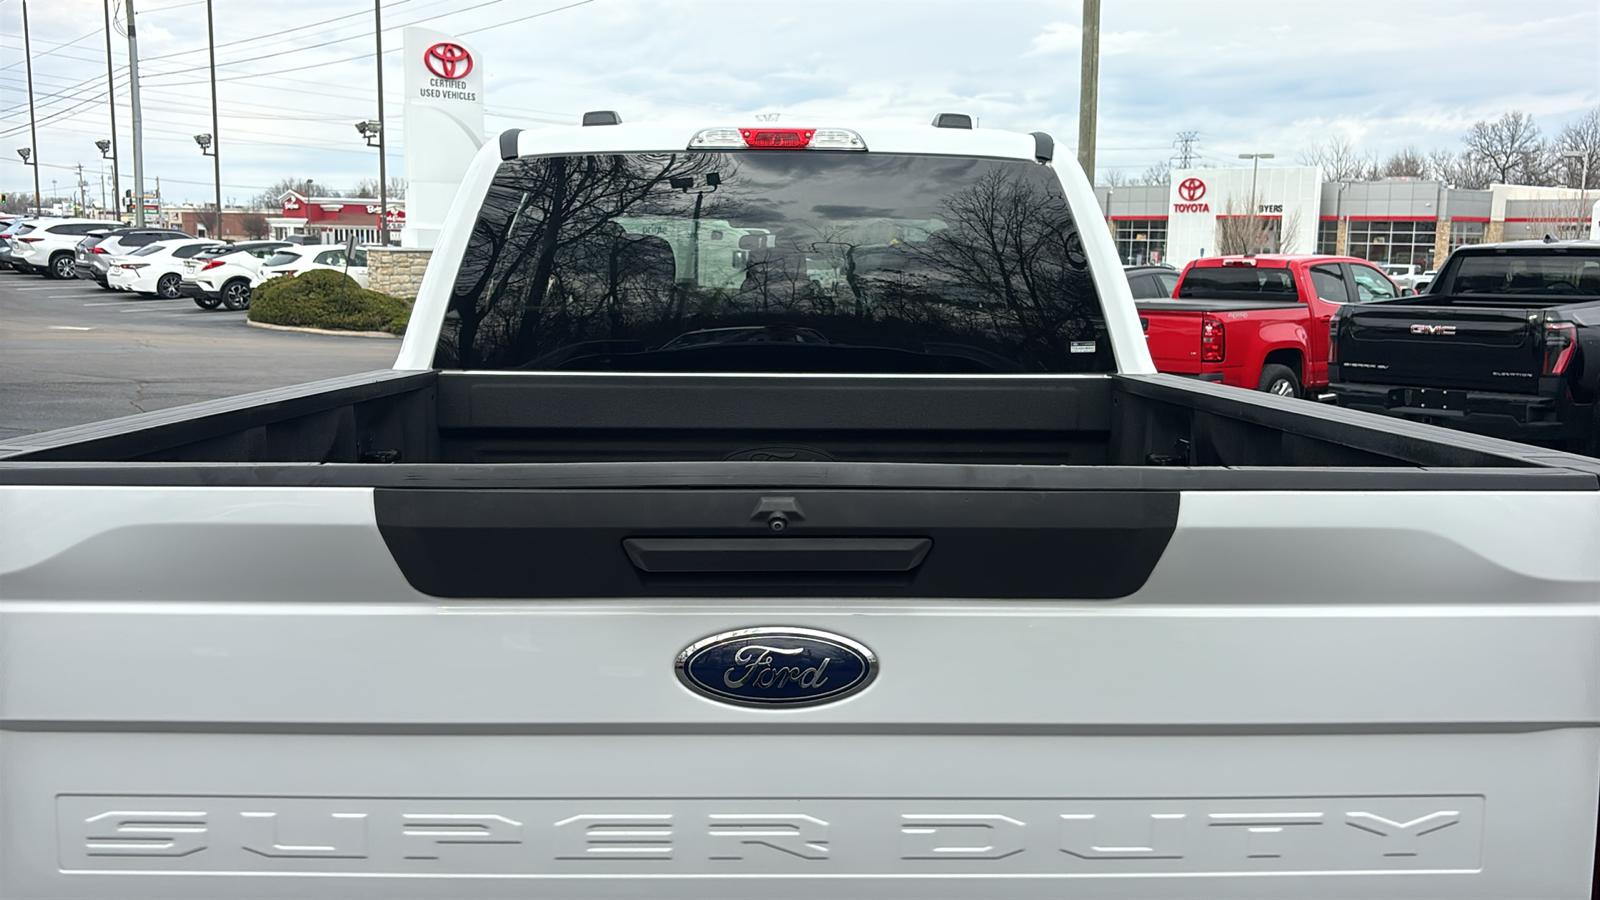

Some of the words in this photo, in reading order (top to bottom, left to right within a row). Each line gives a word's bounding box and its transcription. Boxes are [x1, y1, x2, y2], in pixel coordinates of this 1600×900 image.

[430, 78, 467, 89] CERTIFIED
[420, 88, 441, 98] USED
[442, 90, 476, 101] VEHICLES
[1173, 203, 1210, 213] TOYOTA
[1258, 204, 1283, 213] BYERS
[1410, 324, 1457, 335] GMC
[723, 645, 831, 689] Ford
[85, 810, 829, 860] SUPER
[901, 811, 1460, 859] DUTY
